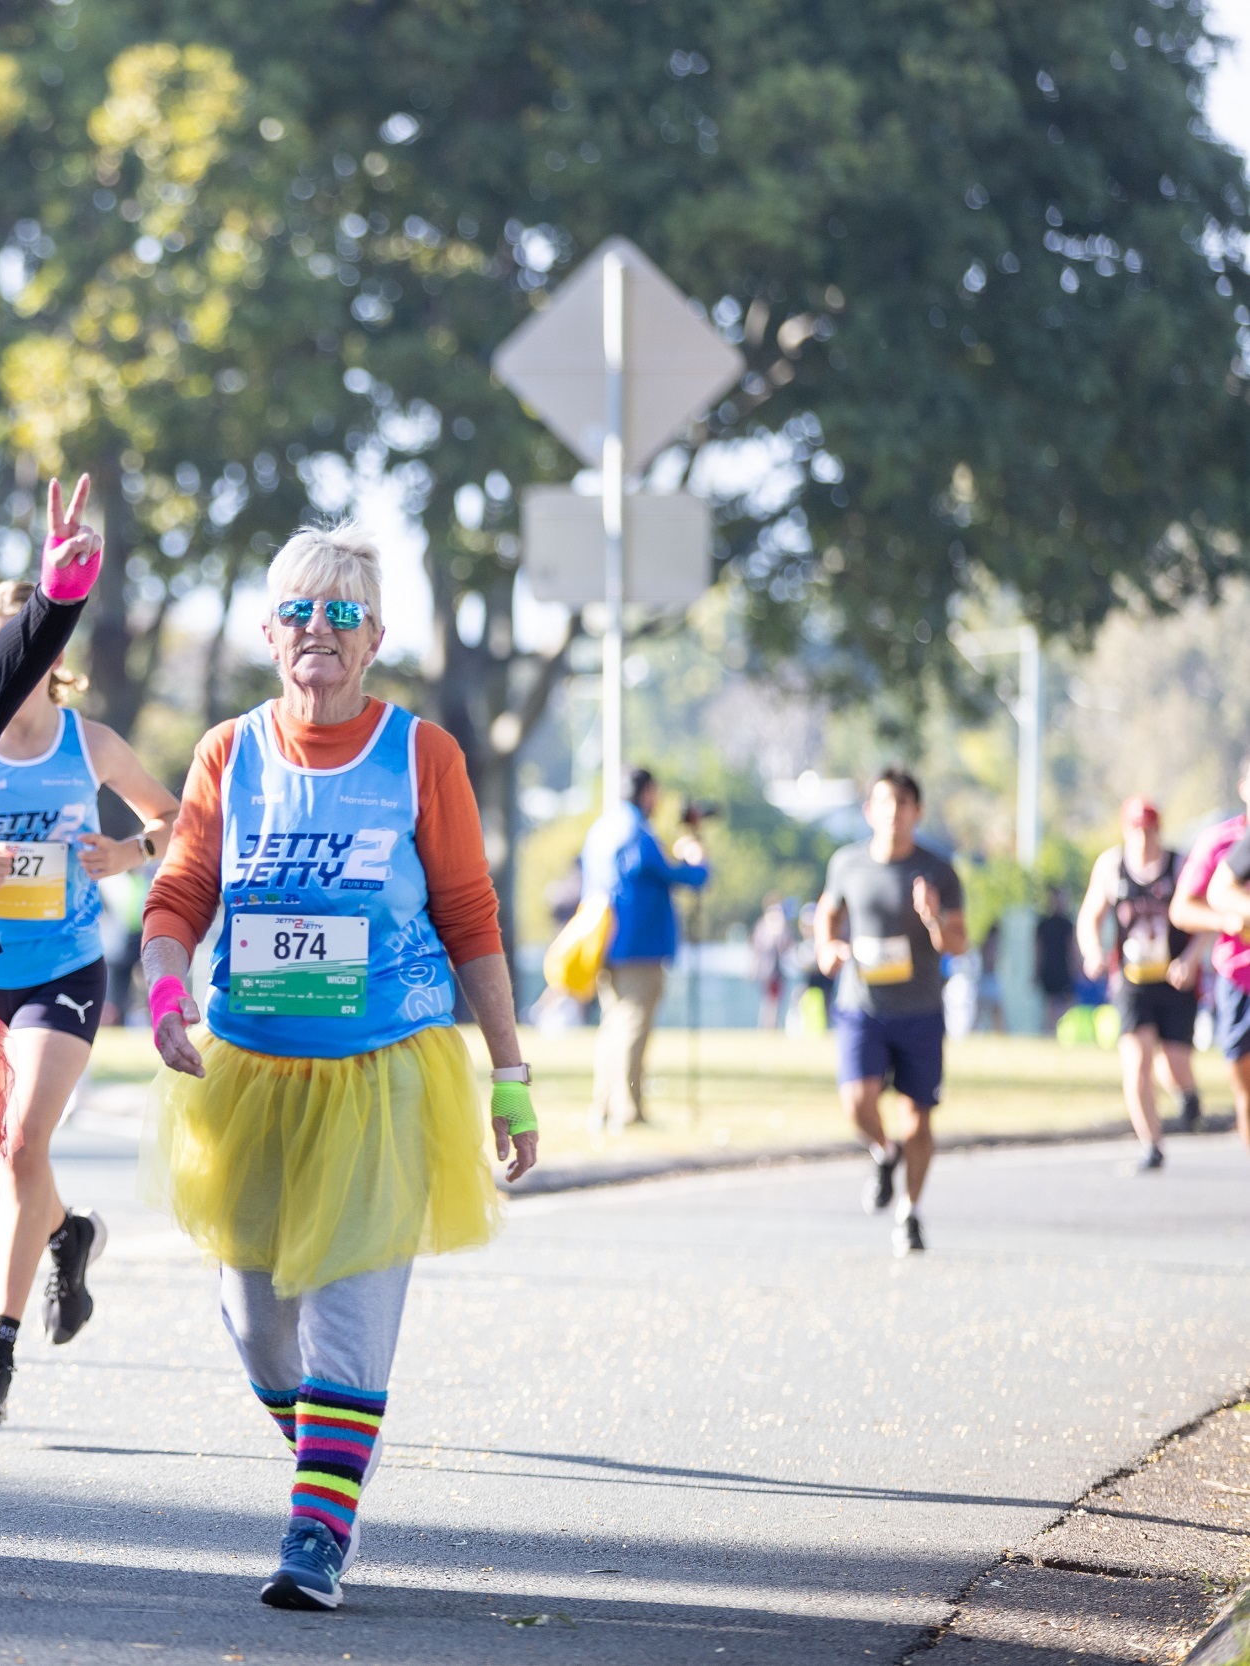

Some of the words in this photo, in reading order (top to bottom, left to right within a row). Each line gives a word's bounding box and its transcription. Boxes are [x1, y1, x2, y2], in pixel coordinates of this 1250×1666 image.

[251, 790, 285, 806] reel
[340, 795, 379, 806] Moreton
[380, 798, 398, 808] Bay
[239, 833, 354, 859] JETTY
[343, 828, 398, 881] 2
[230, 861, 345, 890] JETTY
[362, 881, 382, 889] RUN
[293, 918, 304, 929] 2
[273, 931, 328, 960] 874
[326, 975, 357, 985] WICKED
[340, 1005, 356, 1014] 874
